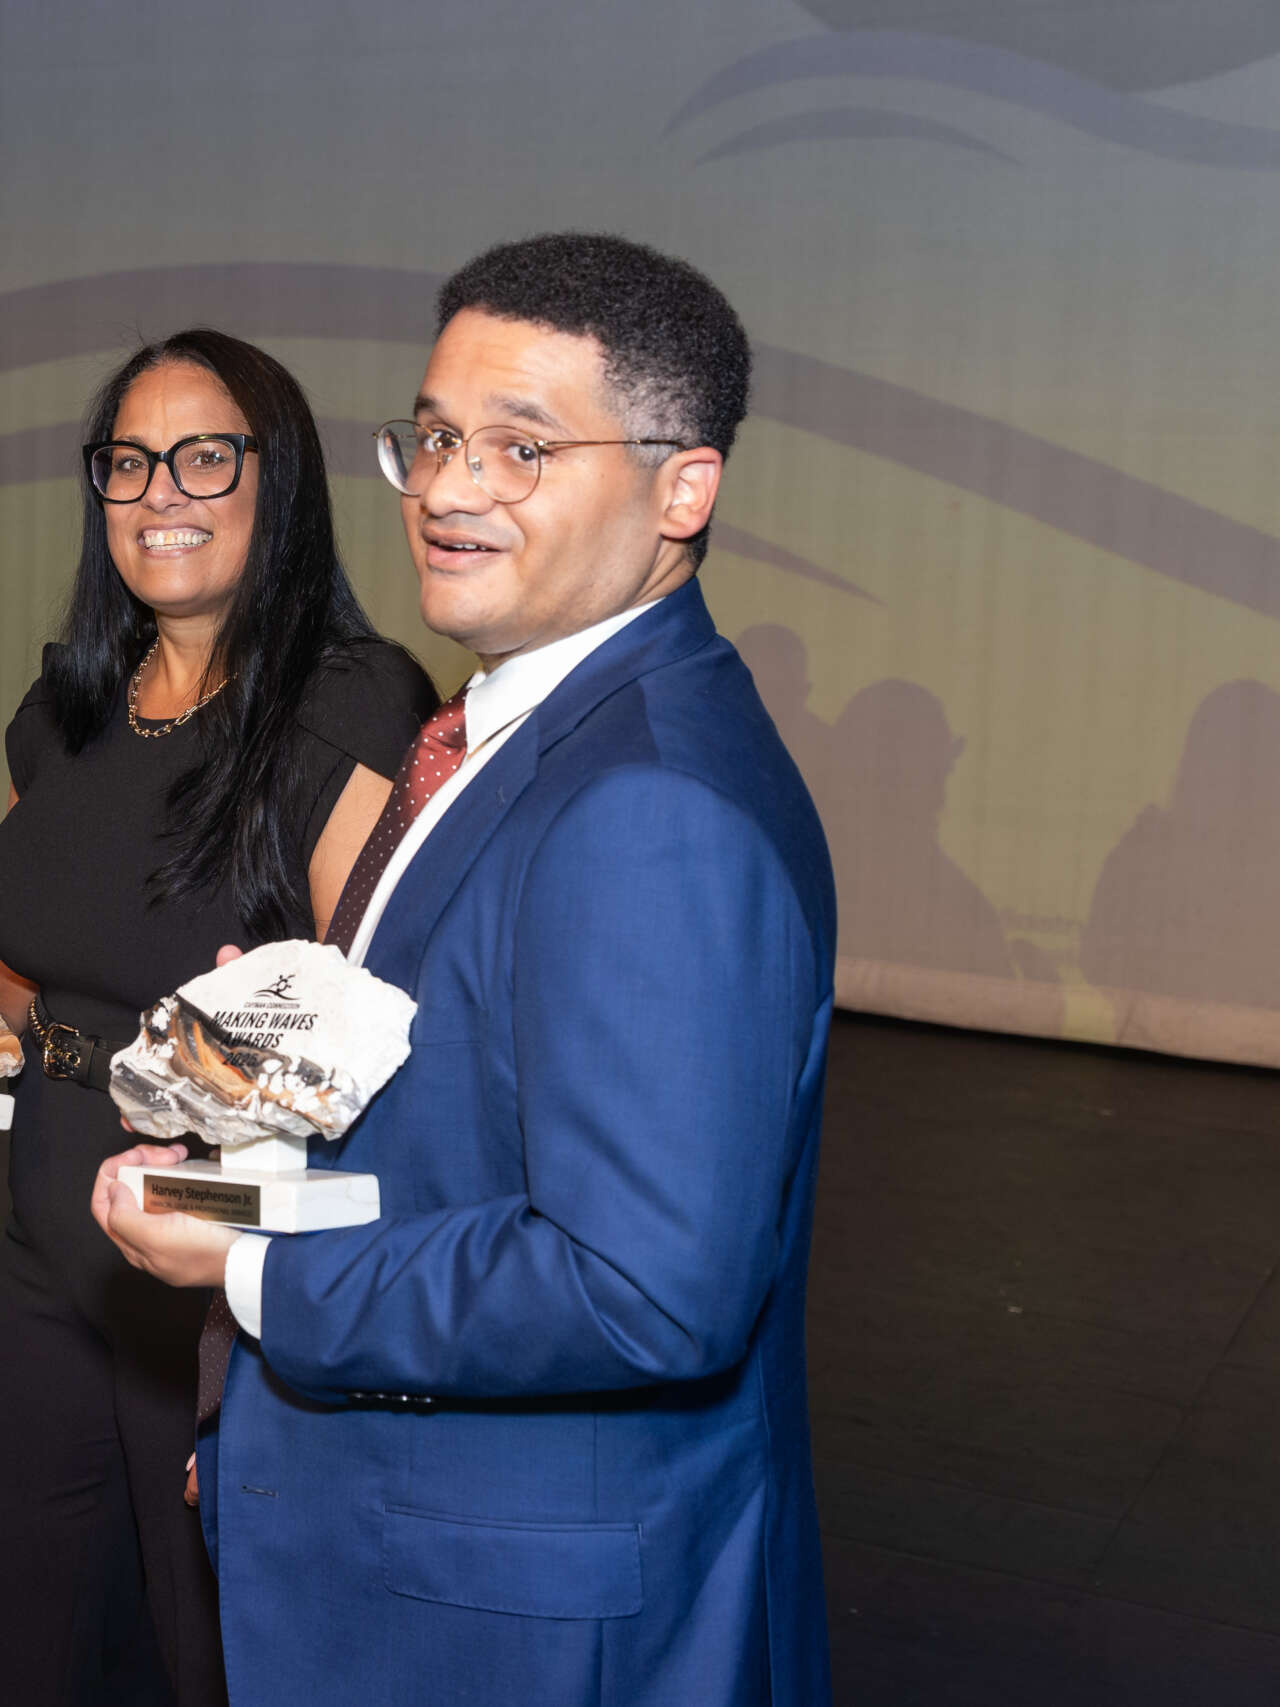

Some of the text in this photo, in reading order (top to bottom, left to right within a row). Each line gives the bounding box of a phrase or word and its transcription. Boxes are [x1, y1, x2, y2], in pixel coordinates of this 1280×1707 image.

[212, 1011, 318, 1031] MAKING WAVES
[221, 1032, 284, 1049] AWARDS
[151, 1183, 183, 1200] Harvey
[184, 1186, 242, 1204] Stephenson
